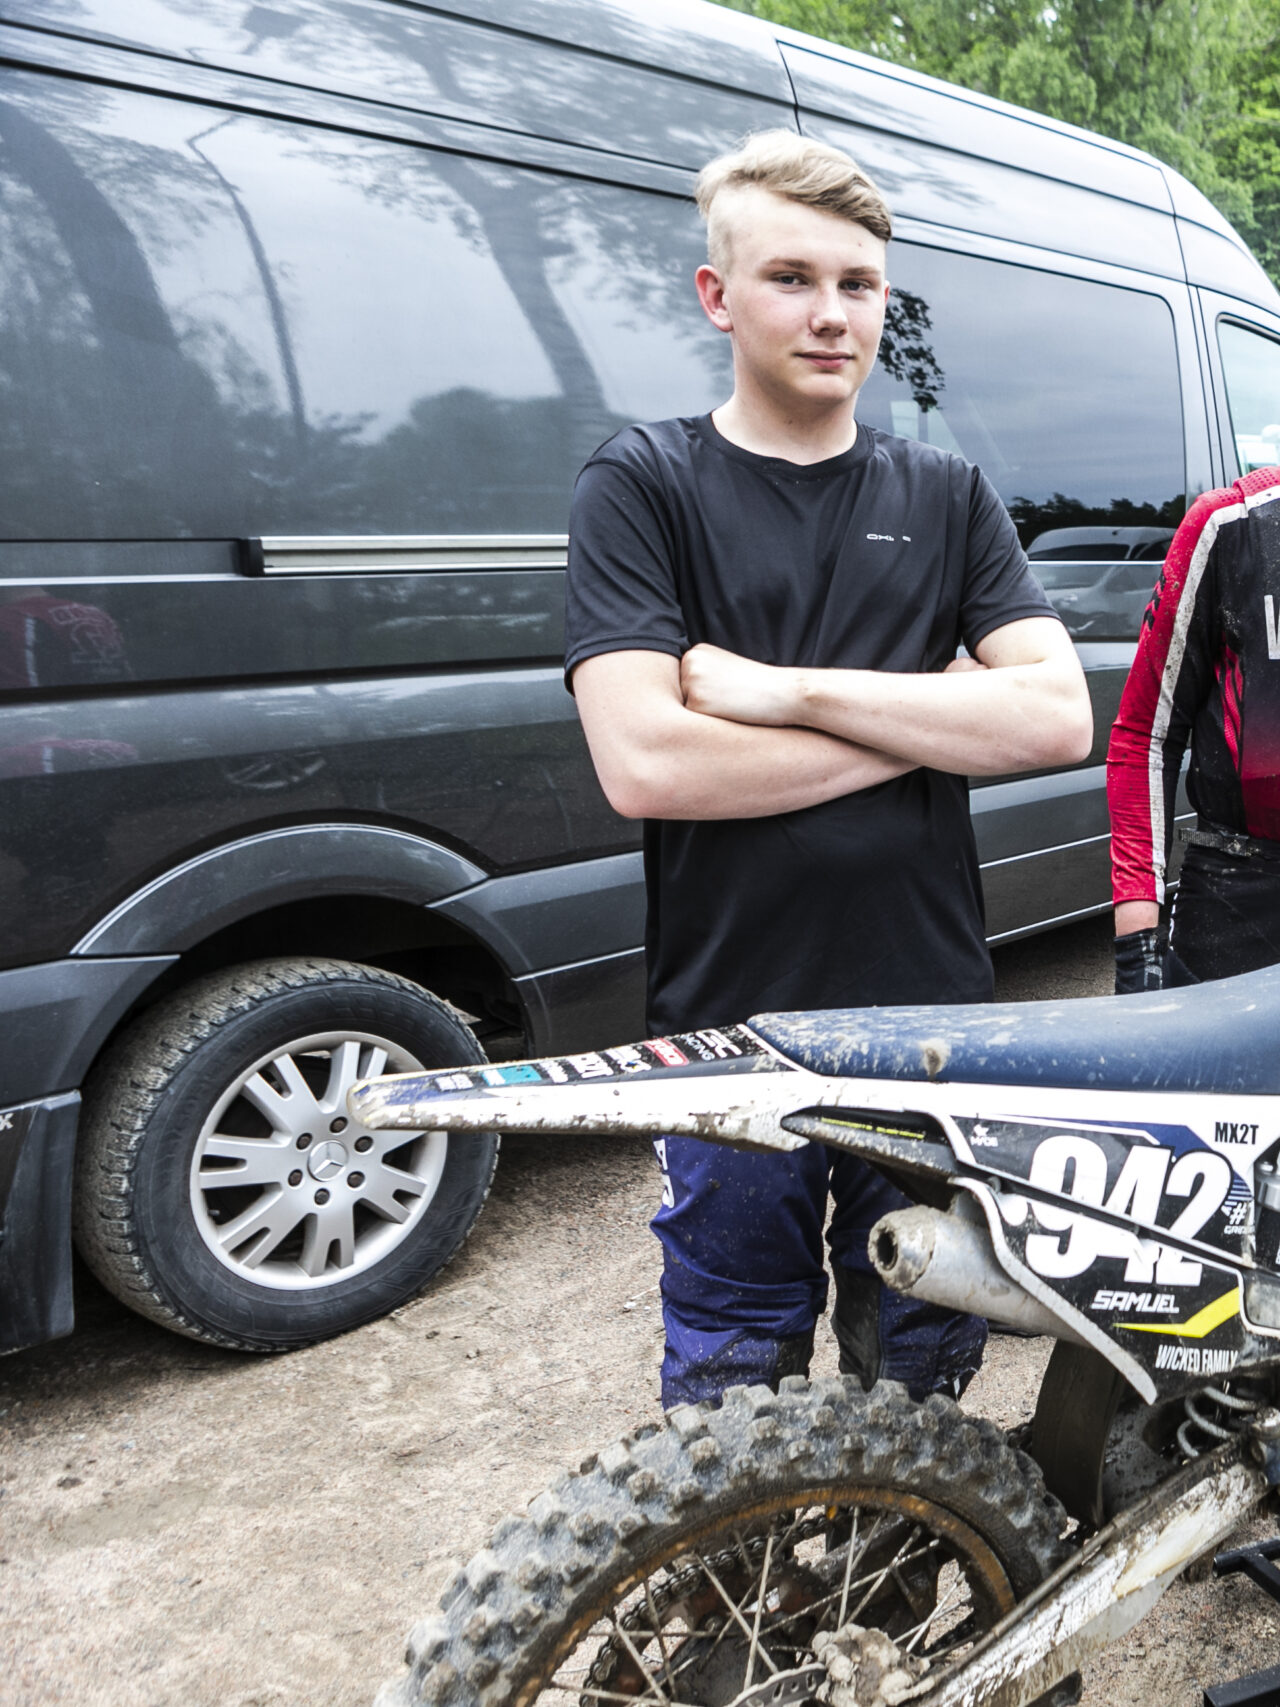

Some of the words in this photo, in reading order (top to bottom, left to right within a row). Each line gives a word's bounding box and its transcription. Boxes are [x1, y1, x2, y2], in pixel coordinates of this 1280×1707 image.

[1214, 1121, 1259, 1145] MX2T
[1025, 1135, 1232, 1287] 942
[1091, 1289, 1180, 1314] SAMUEL
[1155, 1344, 1200, 1372] WICKED
[1202, 1348, 1238, 1374] FAMILY
